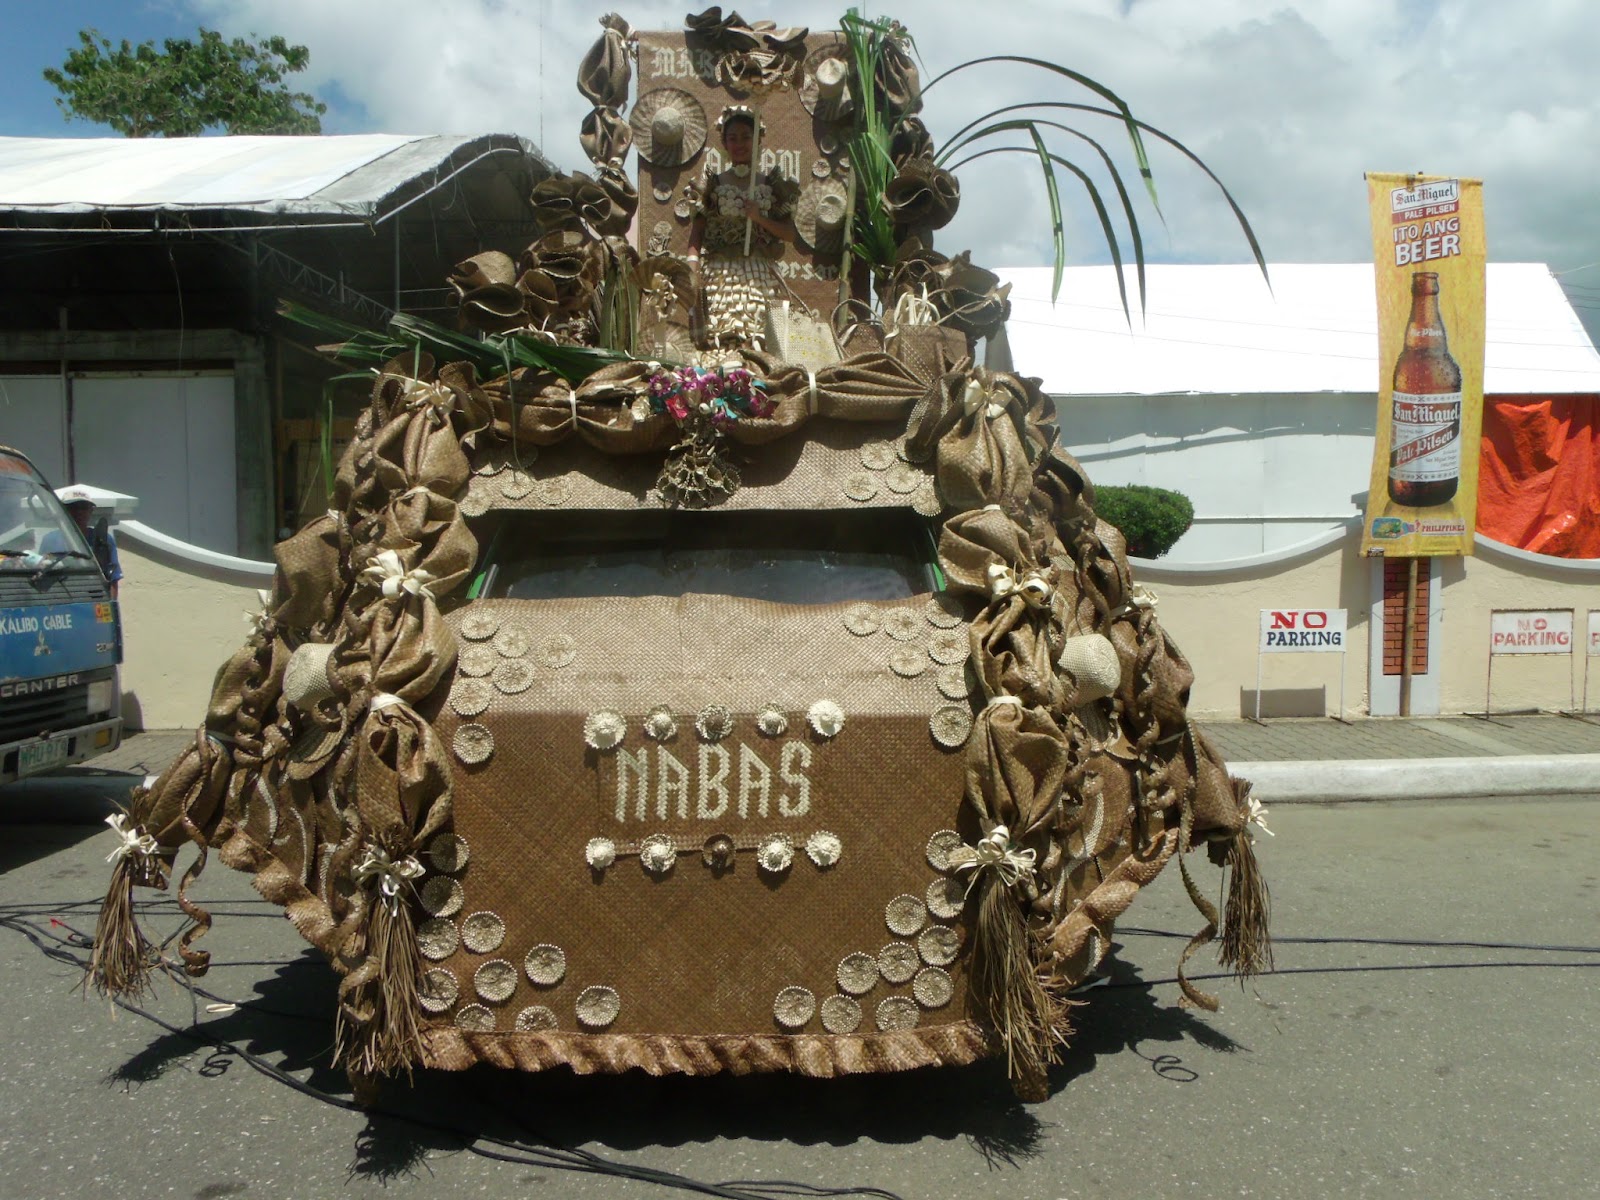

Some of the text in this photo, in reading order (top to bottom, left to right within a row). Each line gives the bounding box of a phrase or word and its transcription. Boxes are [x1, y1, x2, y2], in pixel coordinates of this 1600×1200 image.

[1395, 184, 1454, 205] San Miguel
[1404, 203, 1456, 220] PALE PILSEN
[1393, 216, 1460, 243] ITO ANG
[1395, 234, 1461, 267] BEER
[1394, 404, 1460, 425] San Miguel
[1416, 429, 1454, 456] Pilsen
[0, 614, 73, 635] KALIBO CABLE
[1270, 611, 1328, 629] NO
[1517, 618, 1548, 631] NO
[1266, 631, 1342, 647] PARKING
[1493, 631, 1570, 646] PARKING
[0, 674, 80, 698] CANTER
[615, 740, 813, 824] NABAS
